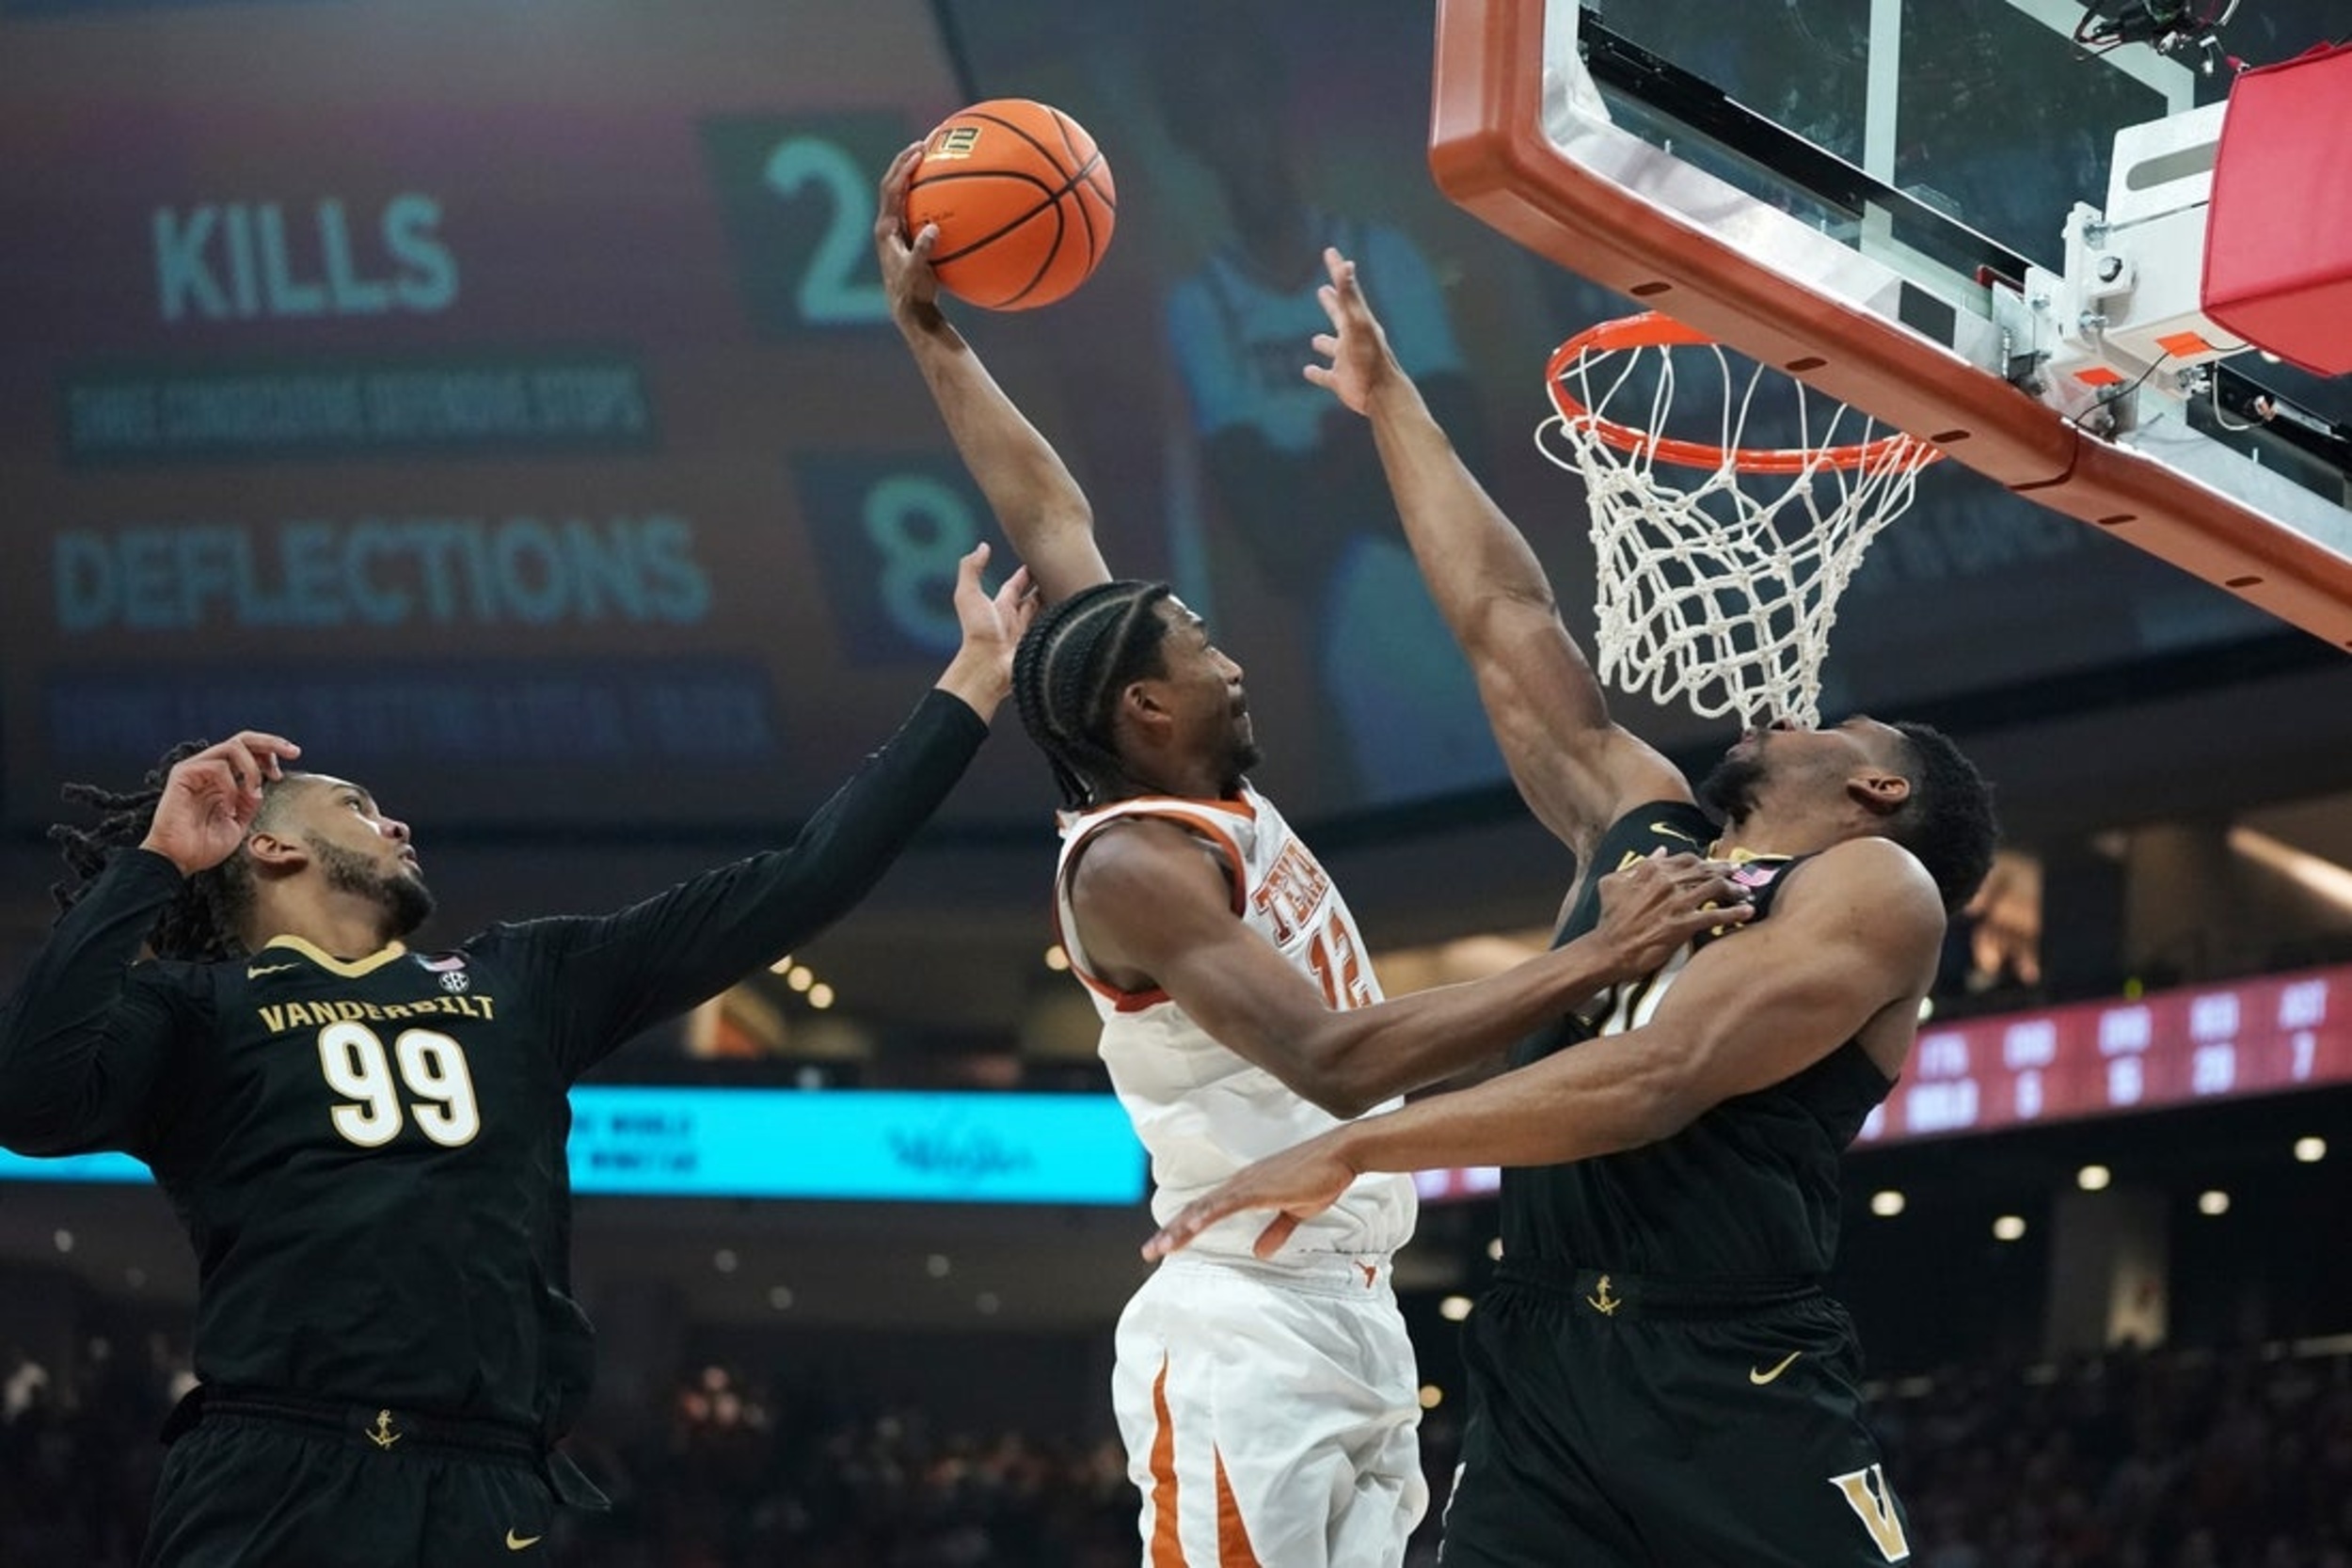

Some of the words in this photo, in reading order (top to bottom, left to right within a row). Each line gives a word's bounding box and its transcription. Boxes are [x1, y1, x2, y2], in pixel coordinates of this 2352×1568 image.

[153, 191, 459, 321] KILLS
[767, 137, 894, 321] 2
[56, 514, 712, 634] DEFLECTIONS
[863, 475, 999, 656] 8
[1249, 835, 1332, 948] TEXA
[258, 995, 495, 1034] VANDERBILT
[1306, 906, 1375, 1013] 12
[317, 1019, 482, 1148] 99
[1827, 1462, 1911, 1563] V
